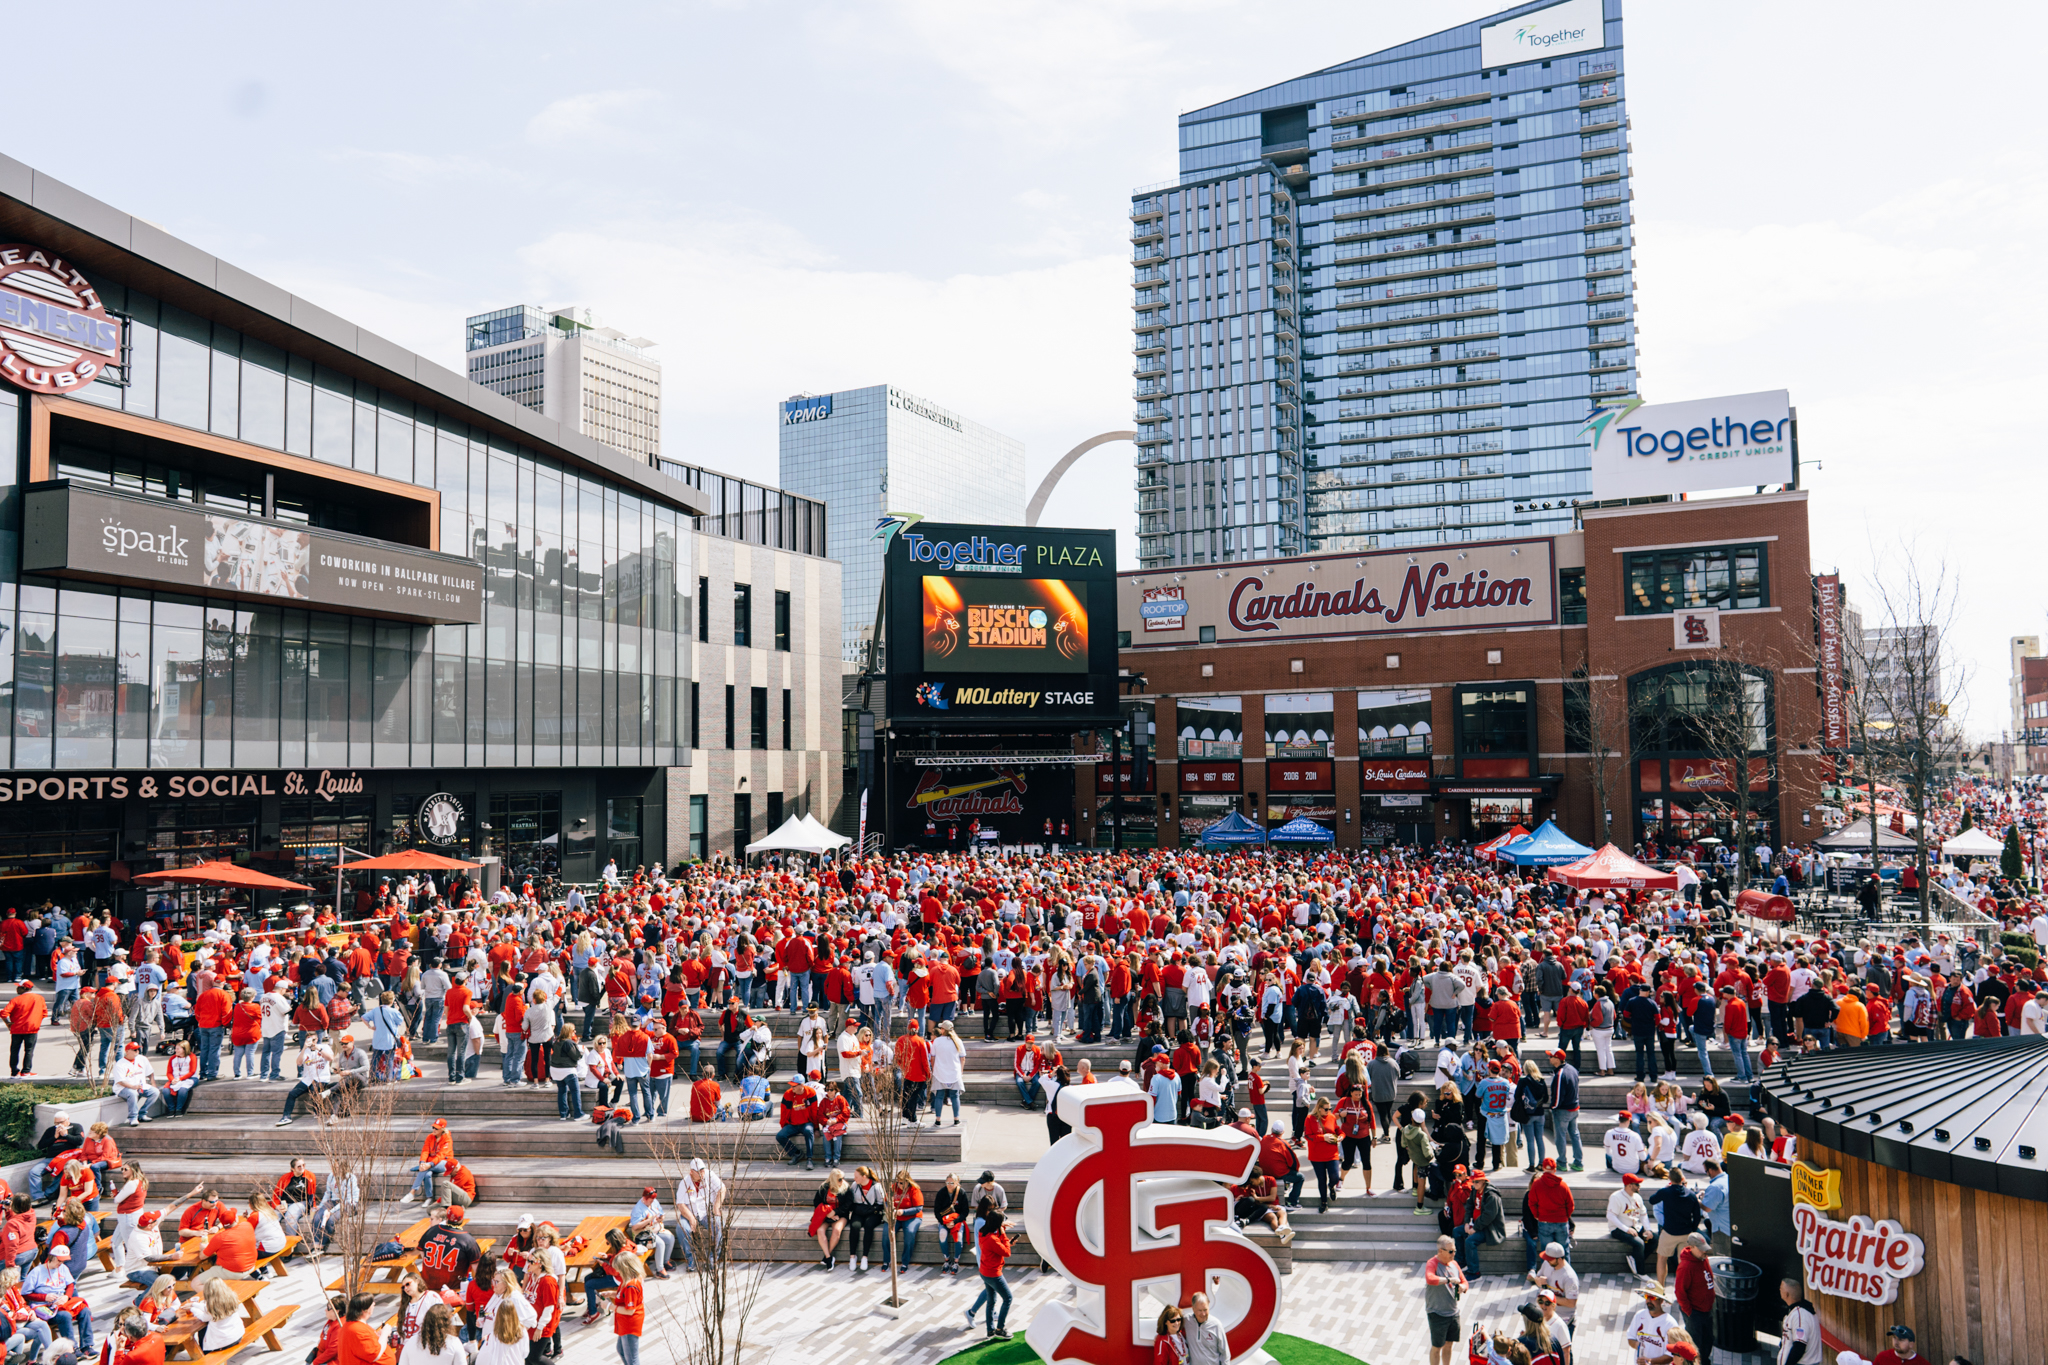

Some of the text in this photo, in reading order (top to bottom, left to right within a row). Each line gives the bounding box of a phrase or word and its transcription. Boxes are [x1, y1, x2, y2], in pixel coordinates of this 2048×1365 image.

[1527, 28, 1585, 47] Together
[0, 248, 102, 310] EALTH
[0, 290, 116, 350] ENESIS
[0, 354, 97, 388] LUBS
[784, 405, 827, 425] KPMG
[1617, 416, 1789, 462] Together
[1699, 445, 1783, 460] CREDIT UNION
[103, 525, 188, 557] spark
[158, 556, 188, 566] ST. LOUIS
[902, 534, 1103, 570] Together PLAZA
[320, 554, 476, 591] COWORKING IN BALLPARK VILLAGE
[338, 576, 357, 588] NOW
[362, 580, 384, 592] OPEN
[396, 586, 461, 604] SPARK-STL.COM
[1228, 562, 1534, 632] Cardinals Nation
[1822, 582, 1835, 616] HALL
[968, 608, 1029, 628] BUSCH
[1144, 604, 1184, 614] ROOFTOP
[968, 626, 1046, 645] STADIUM
[1824, 618, 1836, 634] OF
[1825, 636, 1838, 670] FAME
[955, 688, 1094, 708] MOLottery STAGE
[1827, 686, 1840, 741] MUSEUM
[1186, 772, 1235, 782] 1964 1967 1982
[1284, 772, 1317, 780] 2006 2011
[1365, 768, 1427, 782] St. Louis Cardinals
[1687, 776, 1726, 788] Cardinals
[0, 775, 276, 802] SPORTS & SOCIAL
[284, 770, 364, 802] St. Louis
[424, 796, 442, 818] SPORTS
[450, 796, 464, 815] SOCIAL
[926, 786, 1024, 821] Cardinals
[441, 834, 457, 844] LOUIS
[1600, 855, 1636, 868] Bally
[1610, 877, 1630, 886] Bally
[95, 934, 104, 942] 39
[1002, 958, 1006, 968] 4
[140, 974, 150, 984] 28
[1196, 975, 1206, 986] 44
[1805, 976, 1812, 988] 4
[1355, 1042, 1373, 1050] ARENADO
[1489, 1094, 1506, 1108] 28
[1612, 1134, 1630, 1144] MUSIAL
[1618, 1143, 1626, 1156] 6
[1696, 1144, 1713, 1158] 46
[1796, 1168, 1824, 1190] FARMER
[1798, 1180, 1823, 1202] OWNED
[1796, 1208, 1909, 1270] Prairie
[424, 1240, 460, 1272] 314
[1807, 1254, 1884, 1298] Farms
[1636, 1332, 1662, 1348] Cardinals
